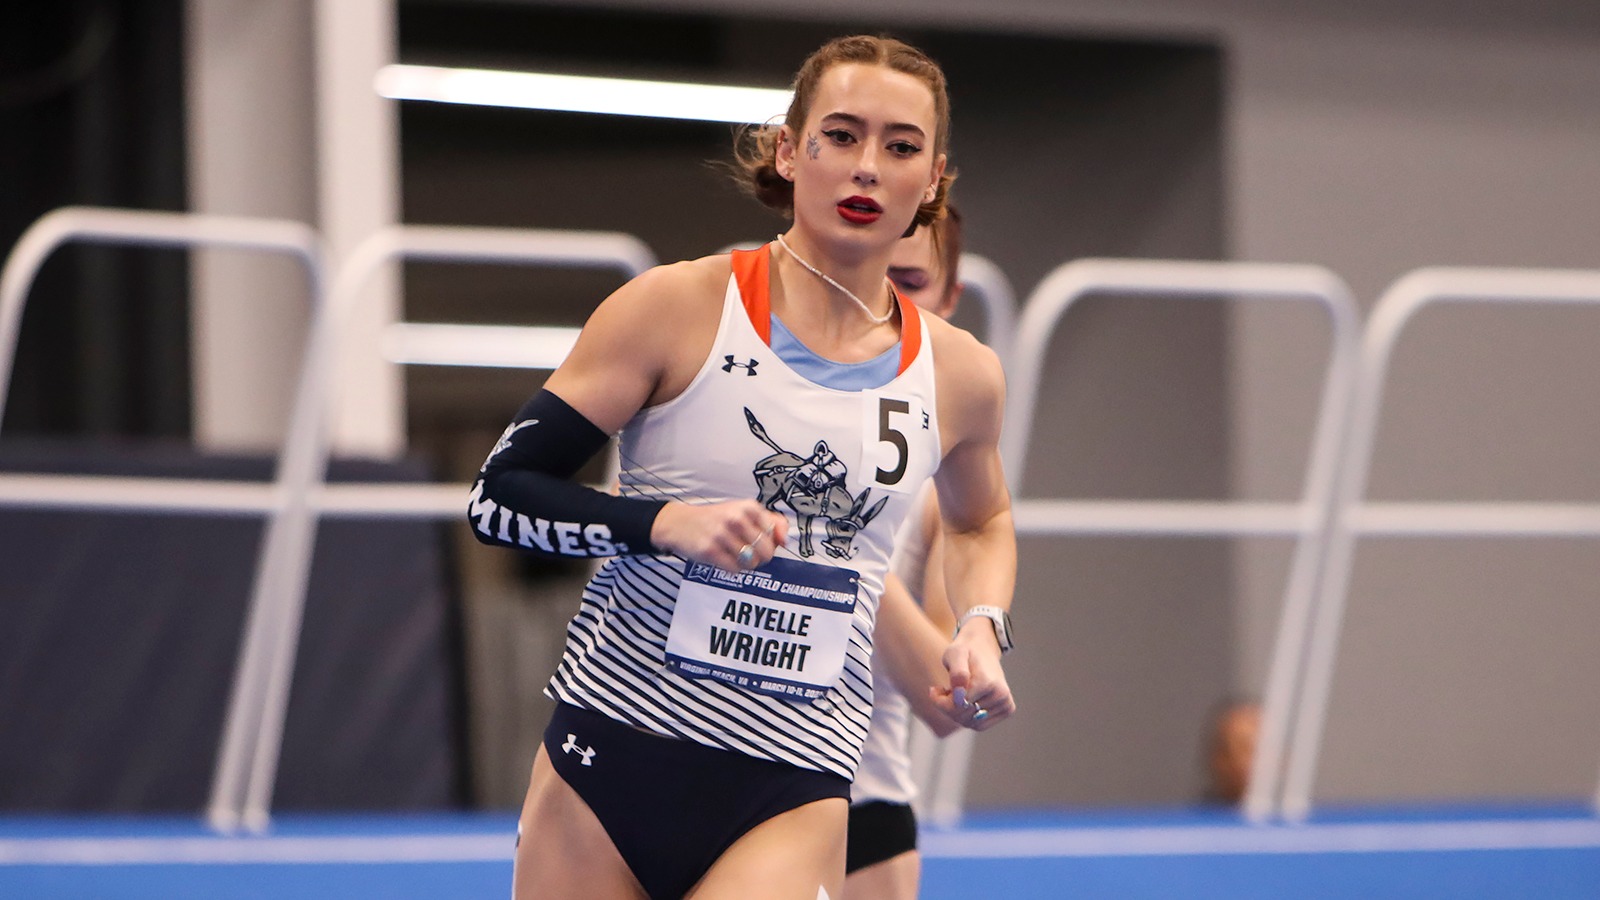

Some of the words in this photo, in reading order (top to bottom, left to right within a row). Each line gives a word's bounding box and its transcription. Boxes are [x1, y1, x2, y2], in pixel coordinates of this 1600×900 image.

[874, 397, 909, 485] 5
[712, 567, 744, 584] TRACK
[743, 575, 752, 586] &
[752, 576, 781, 592] FIELD
[780, 582, 855, 605] CHAMPIONSHIPS
[721, 599, 812, 637] ARYELLE
[709, 625, 811, 672] WRIGHT
[679, 661, 710, 676] VIRGINIA
[738, 676, 750, 686] VA
[760, 680, 787, 694] MARCH
